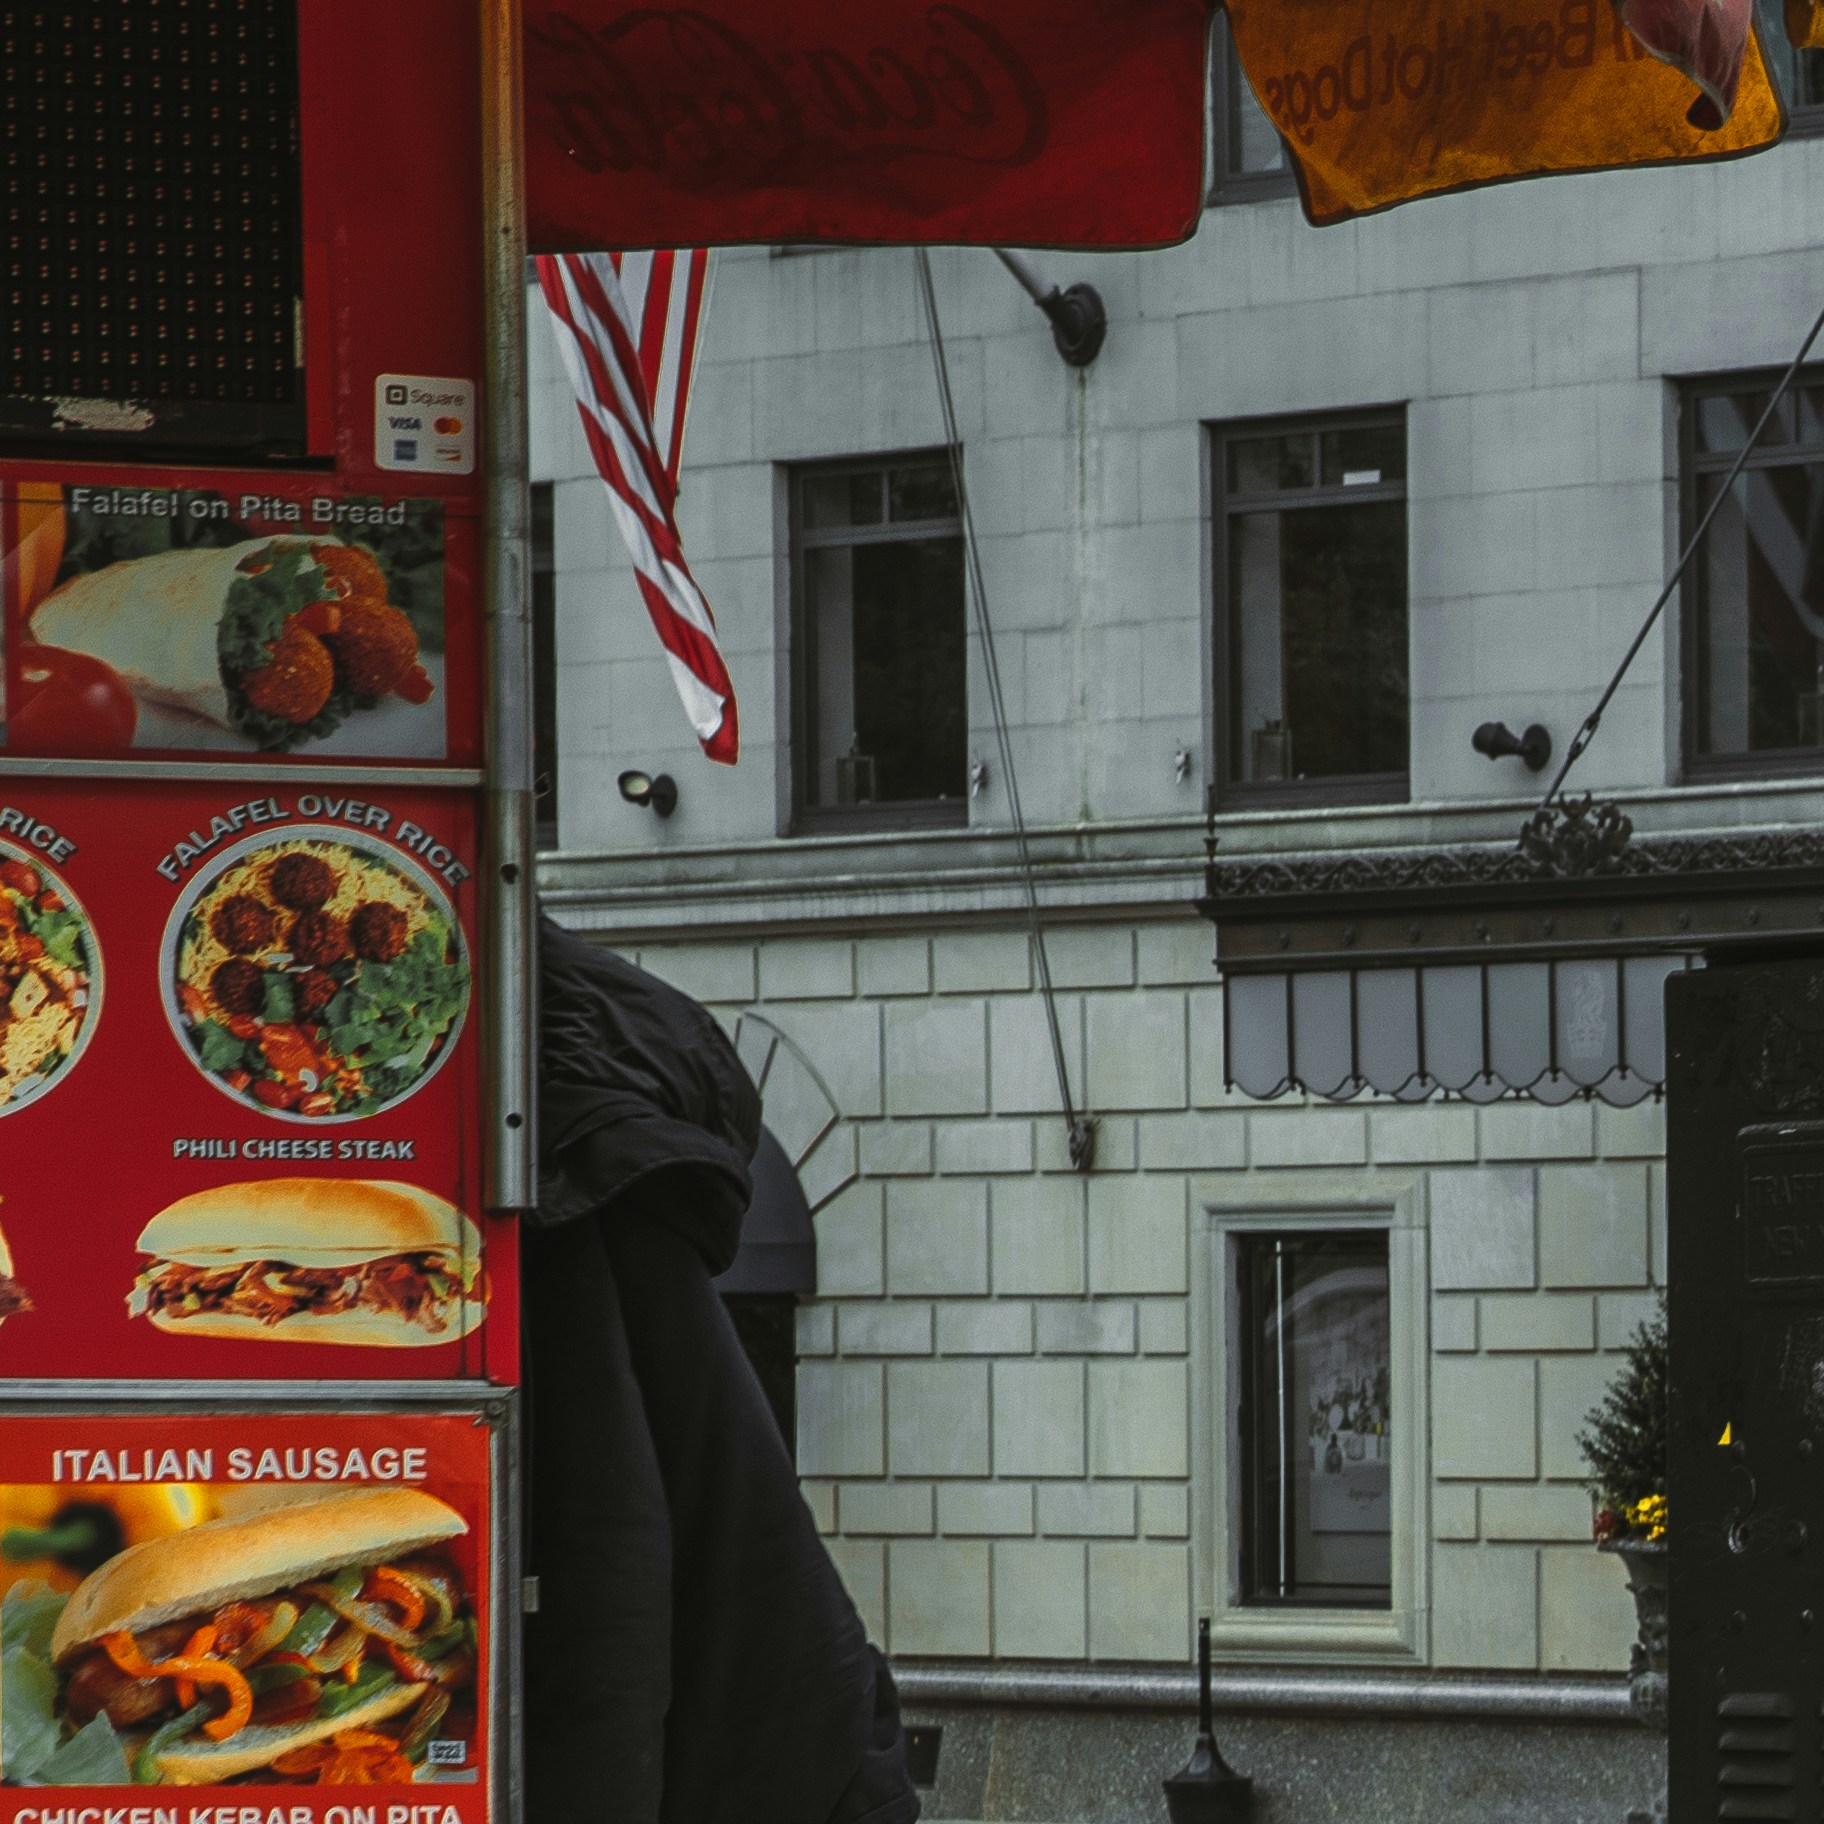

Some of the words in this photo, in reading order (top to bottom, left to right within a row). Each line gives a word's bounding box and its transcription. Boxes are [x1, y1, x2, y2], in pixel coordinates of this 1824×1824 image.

[410, 388, 464, 407] Square
[387, 416, 422, 430] VISA
[70, 487, 178, 518] Falafel
[188, 497, 229, 519] on
[239, 495, 301, 522] Pita
[312, 497, 406, 526] Bread
[0, 806, 78, 865] RICE
[156, 797, 290, 882] FALAFEL
[297, 794, 391, 831] OVER
[395, 820, 471, 888] RICE
[173, 1138, 237, 1160] PHILI
[242, 1138, 333, 1161] CHEESE
[337, 1138, 416, 1161] STEAK
[1763, 1222, 1811, 1256] NEW
[52, 1449, 213, 1482] ITALIAN
[227, 1447, 428, 1481] SAUSAGE
